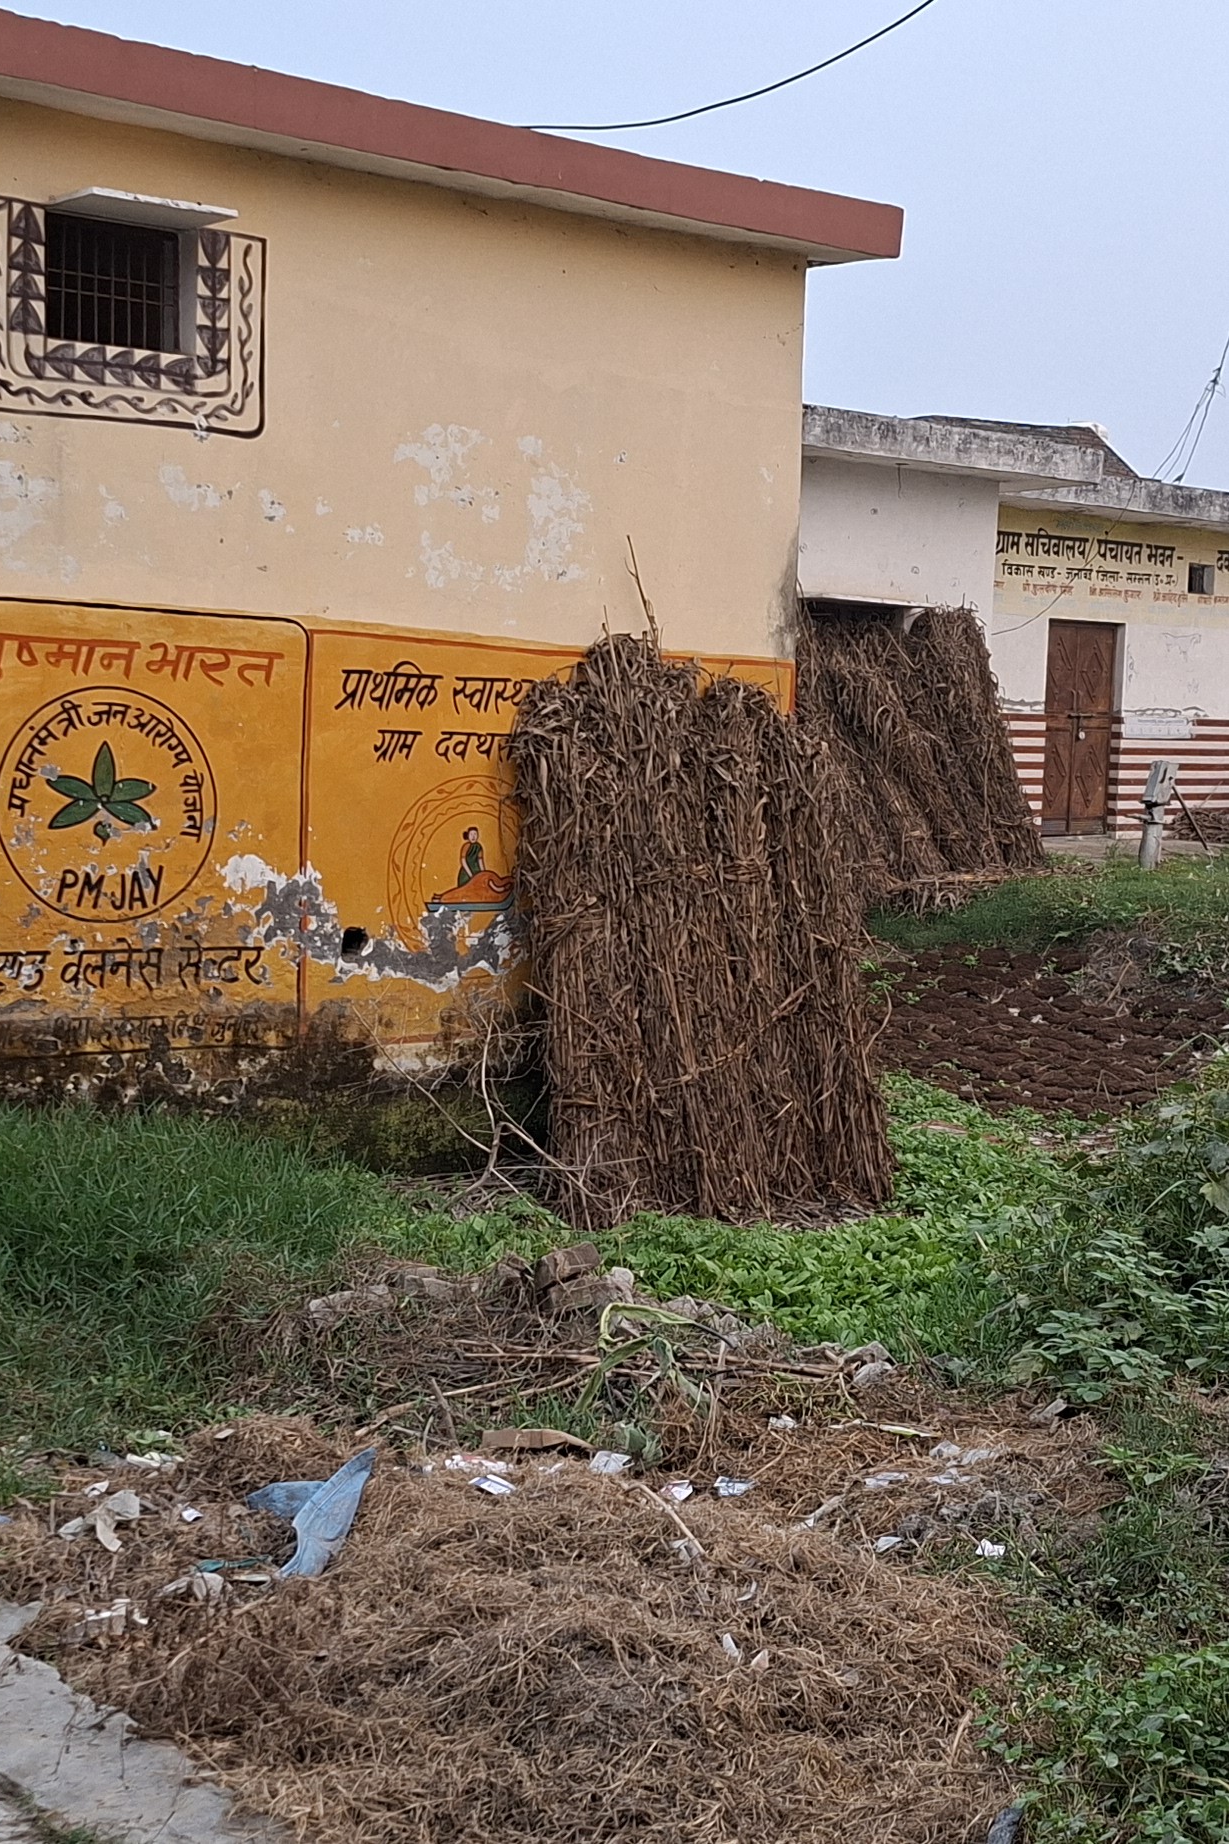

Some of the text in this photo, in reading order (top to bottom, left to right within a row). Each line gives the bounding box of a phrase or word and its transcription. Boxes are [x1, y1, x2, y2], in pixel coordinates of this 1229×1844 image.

[1000, 558, 1035, 577] विकास
[1097, 530, 1143, 565] पंचायत
[144, 641, 285, 688] भारत
[334, 660, 444, 713] प्राथमिक
[373, 728, 422, 763] ग्राम
[87, 701, 131, 727] जन
[179, 769, 205, 843] योजना
